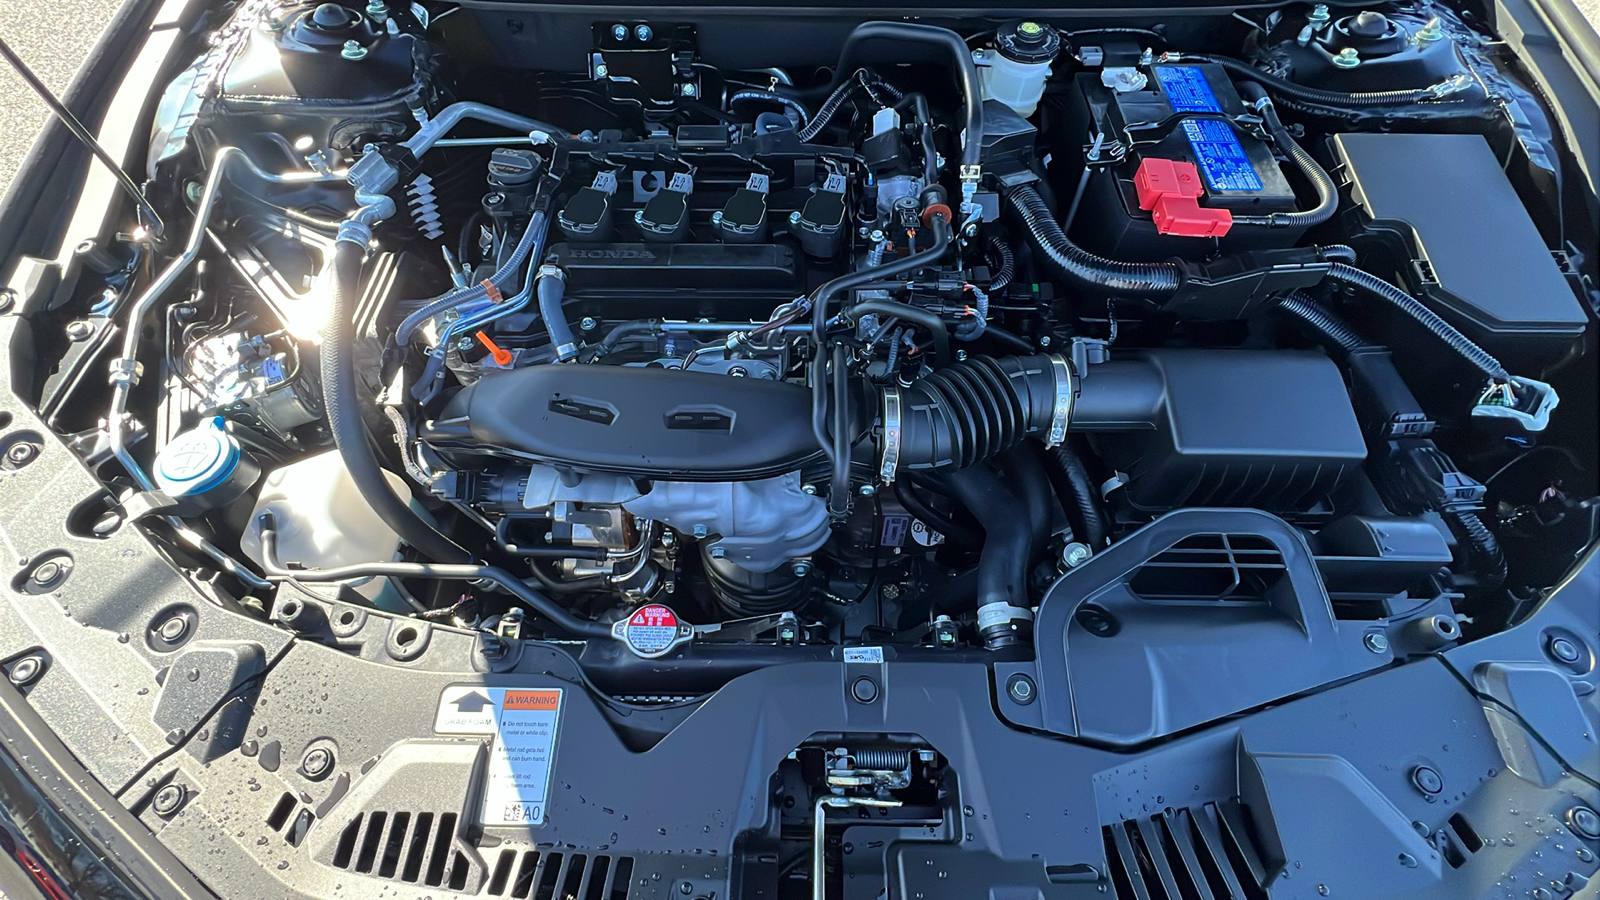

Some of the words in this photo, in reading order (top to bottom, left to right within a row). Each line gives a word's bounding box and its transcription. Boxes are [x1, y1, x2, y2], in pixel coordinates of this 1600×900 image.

[569, 249, 657, 259] HONDA
[516, 696, 557, 704] WARNING
[521, 805, 540, 821] A0
